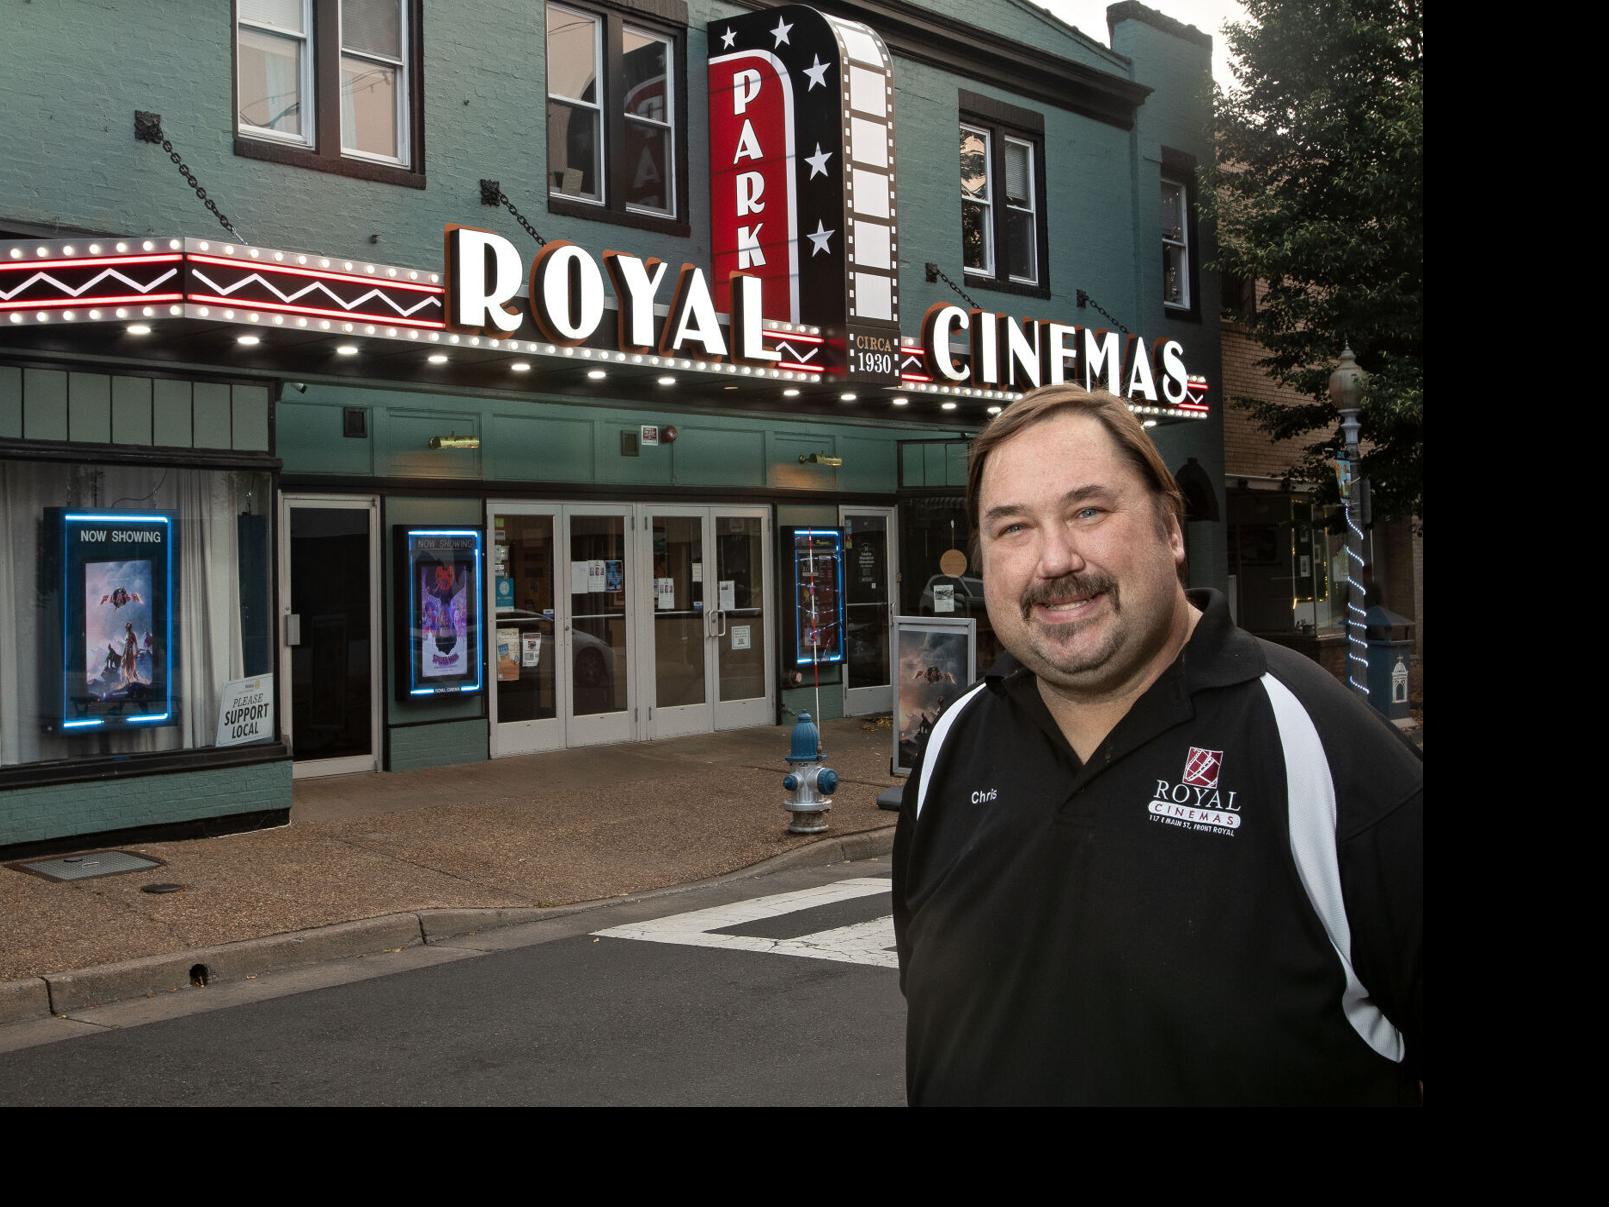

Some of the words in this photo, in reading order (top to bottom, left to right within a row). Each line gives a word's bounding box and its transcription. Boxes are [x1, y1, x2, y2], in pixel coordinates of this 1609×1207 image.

[733, 68, 767, 270] PARK
[456, 227, 783, 362] ROYAL
[931, 305, 1190, 405] CINEMAS
[856, 335, 892, 352] CIRCA
[857, 352, 892, 374] 1930
[80, 530, 107, 543] NOW
[111, 530, 161, 543] SHOWING
[232, 692, 264, 709] PLEASE
[224, 702, 270, 727] SUPPORT
[231, 722, 259, 739] LOCAL
[971, 788, 998, 804] Chris
[1153, 779, 1242, 812] ROYAL
[1154, 803, 1234, 825] CINEMAS
[1165, 818, 1182, 827] MAIN
[1193, 823, 1212, 833] FRONT
[1212, 826, 1235, 837] ROYAL
